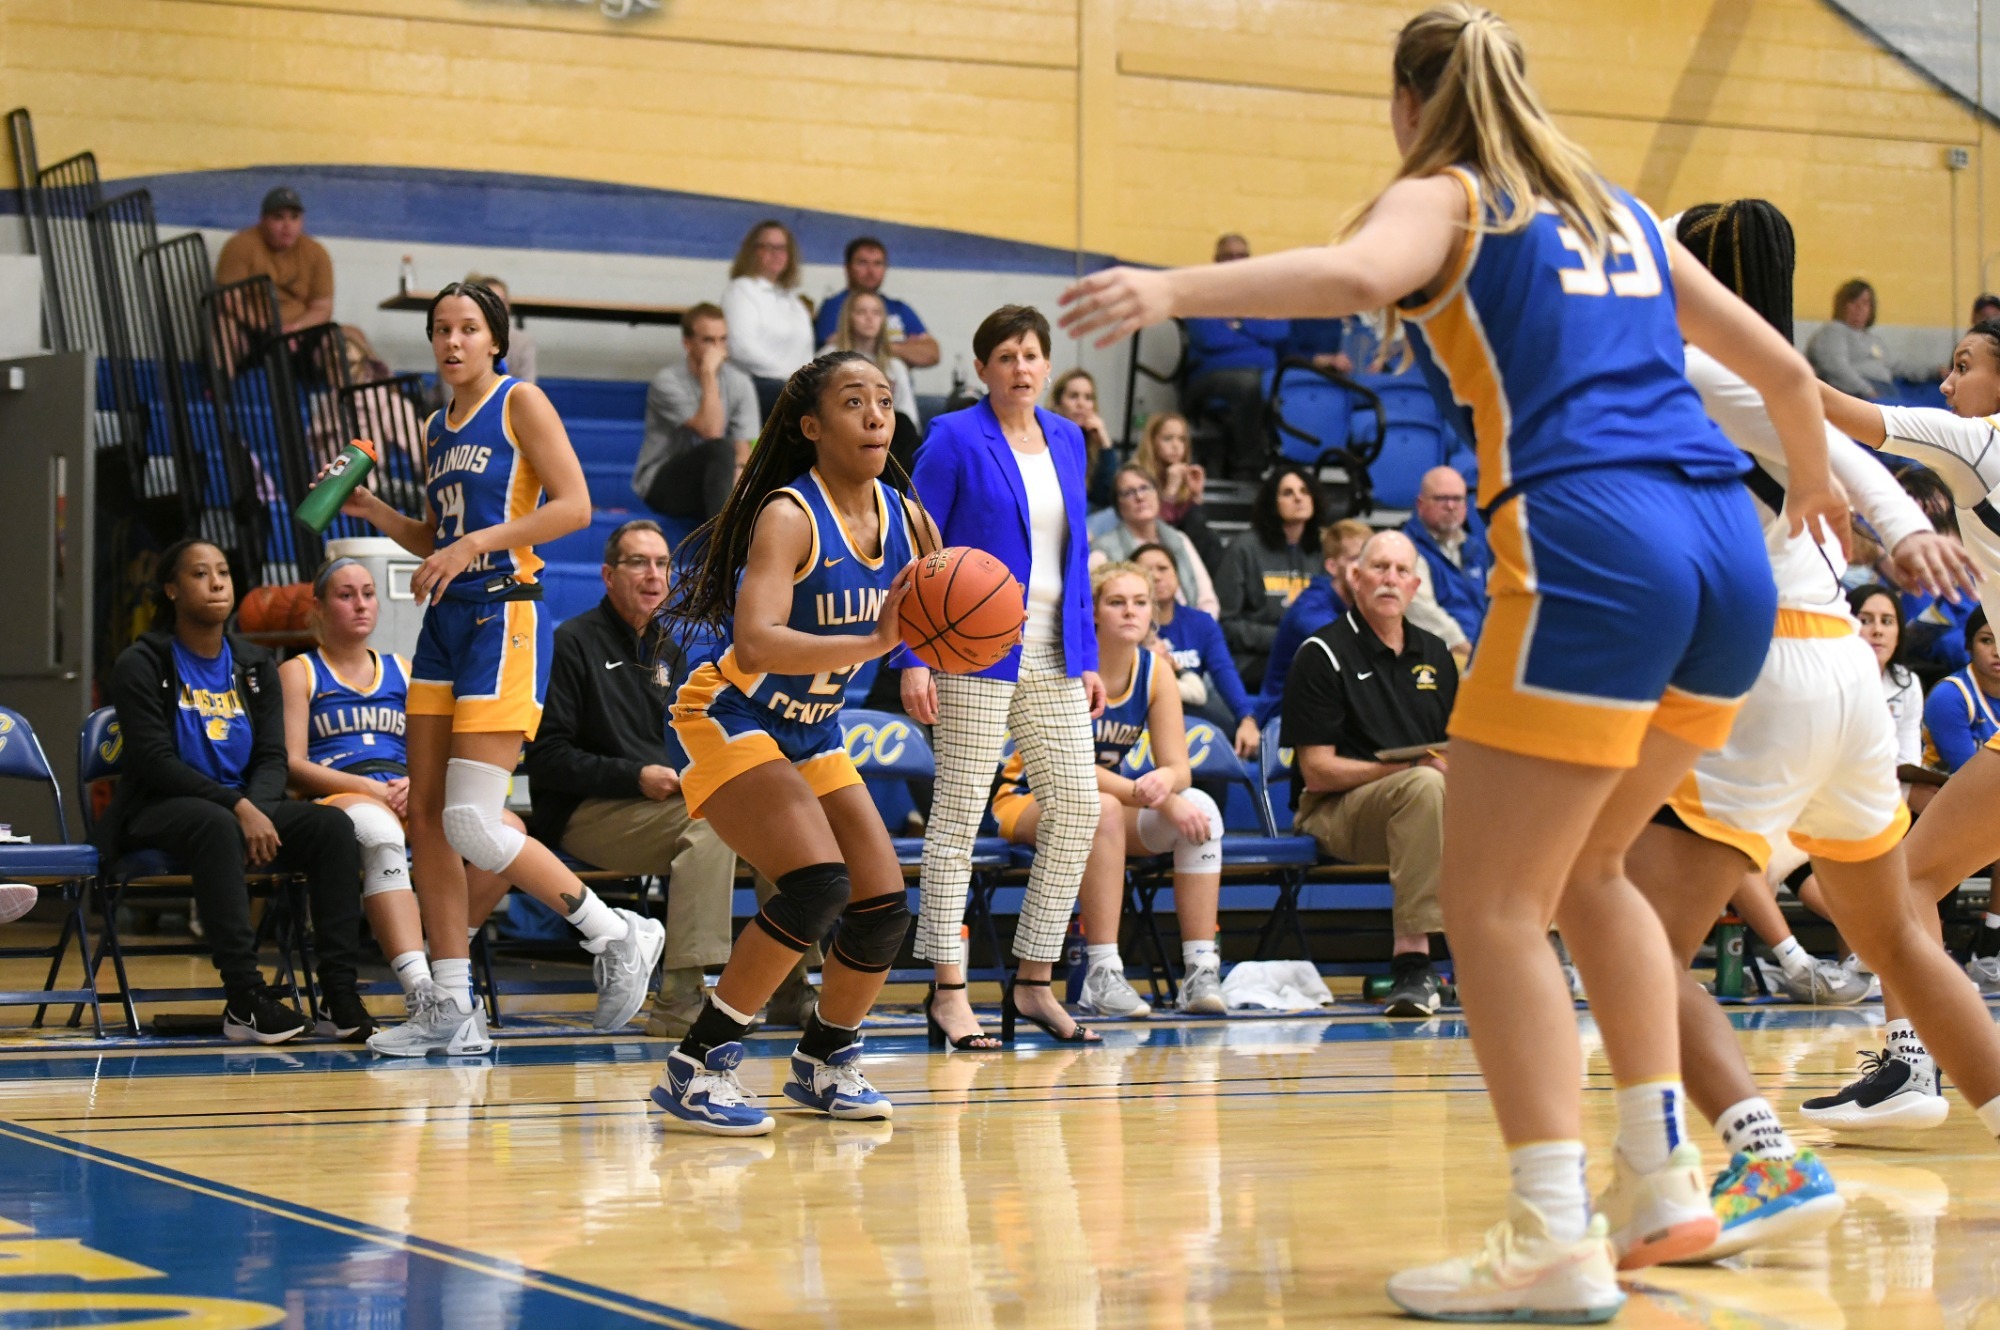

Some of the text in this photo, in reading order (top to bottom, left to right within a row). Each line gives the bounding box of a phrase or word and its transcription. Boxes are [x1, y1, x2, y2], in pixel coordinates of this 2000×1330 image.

[428, 444, 493, 484] LLINOIS
[437, 482, 466, 539] 14
[815, 587, 890, 626] ILLIN
[314, 706, 407, 738] ILLINOIS
[843, 721, 911, 768] CC
